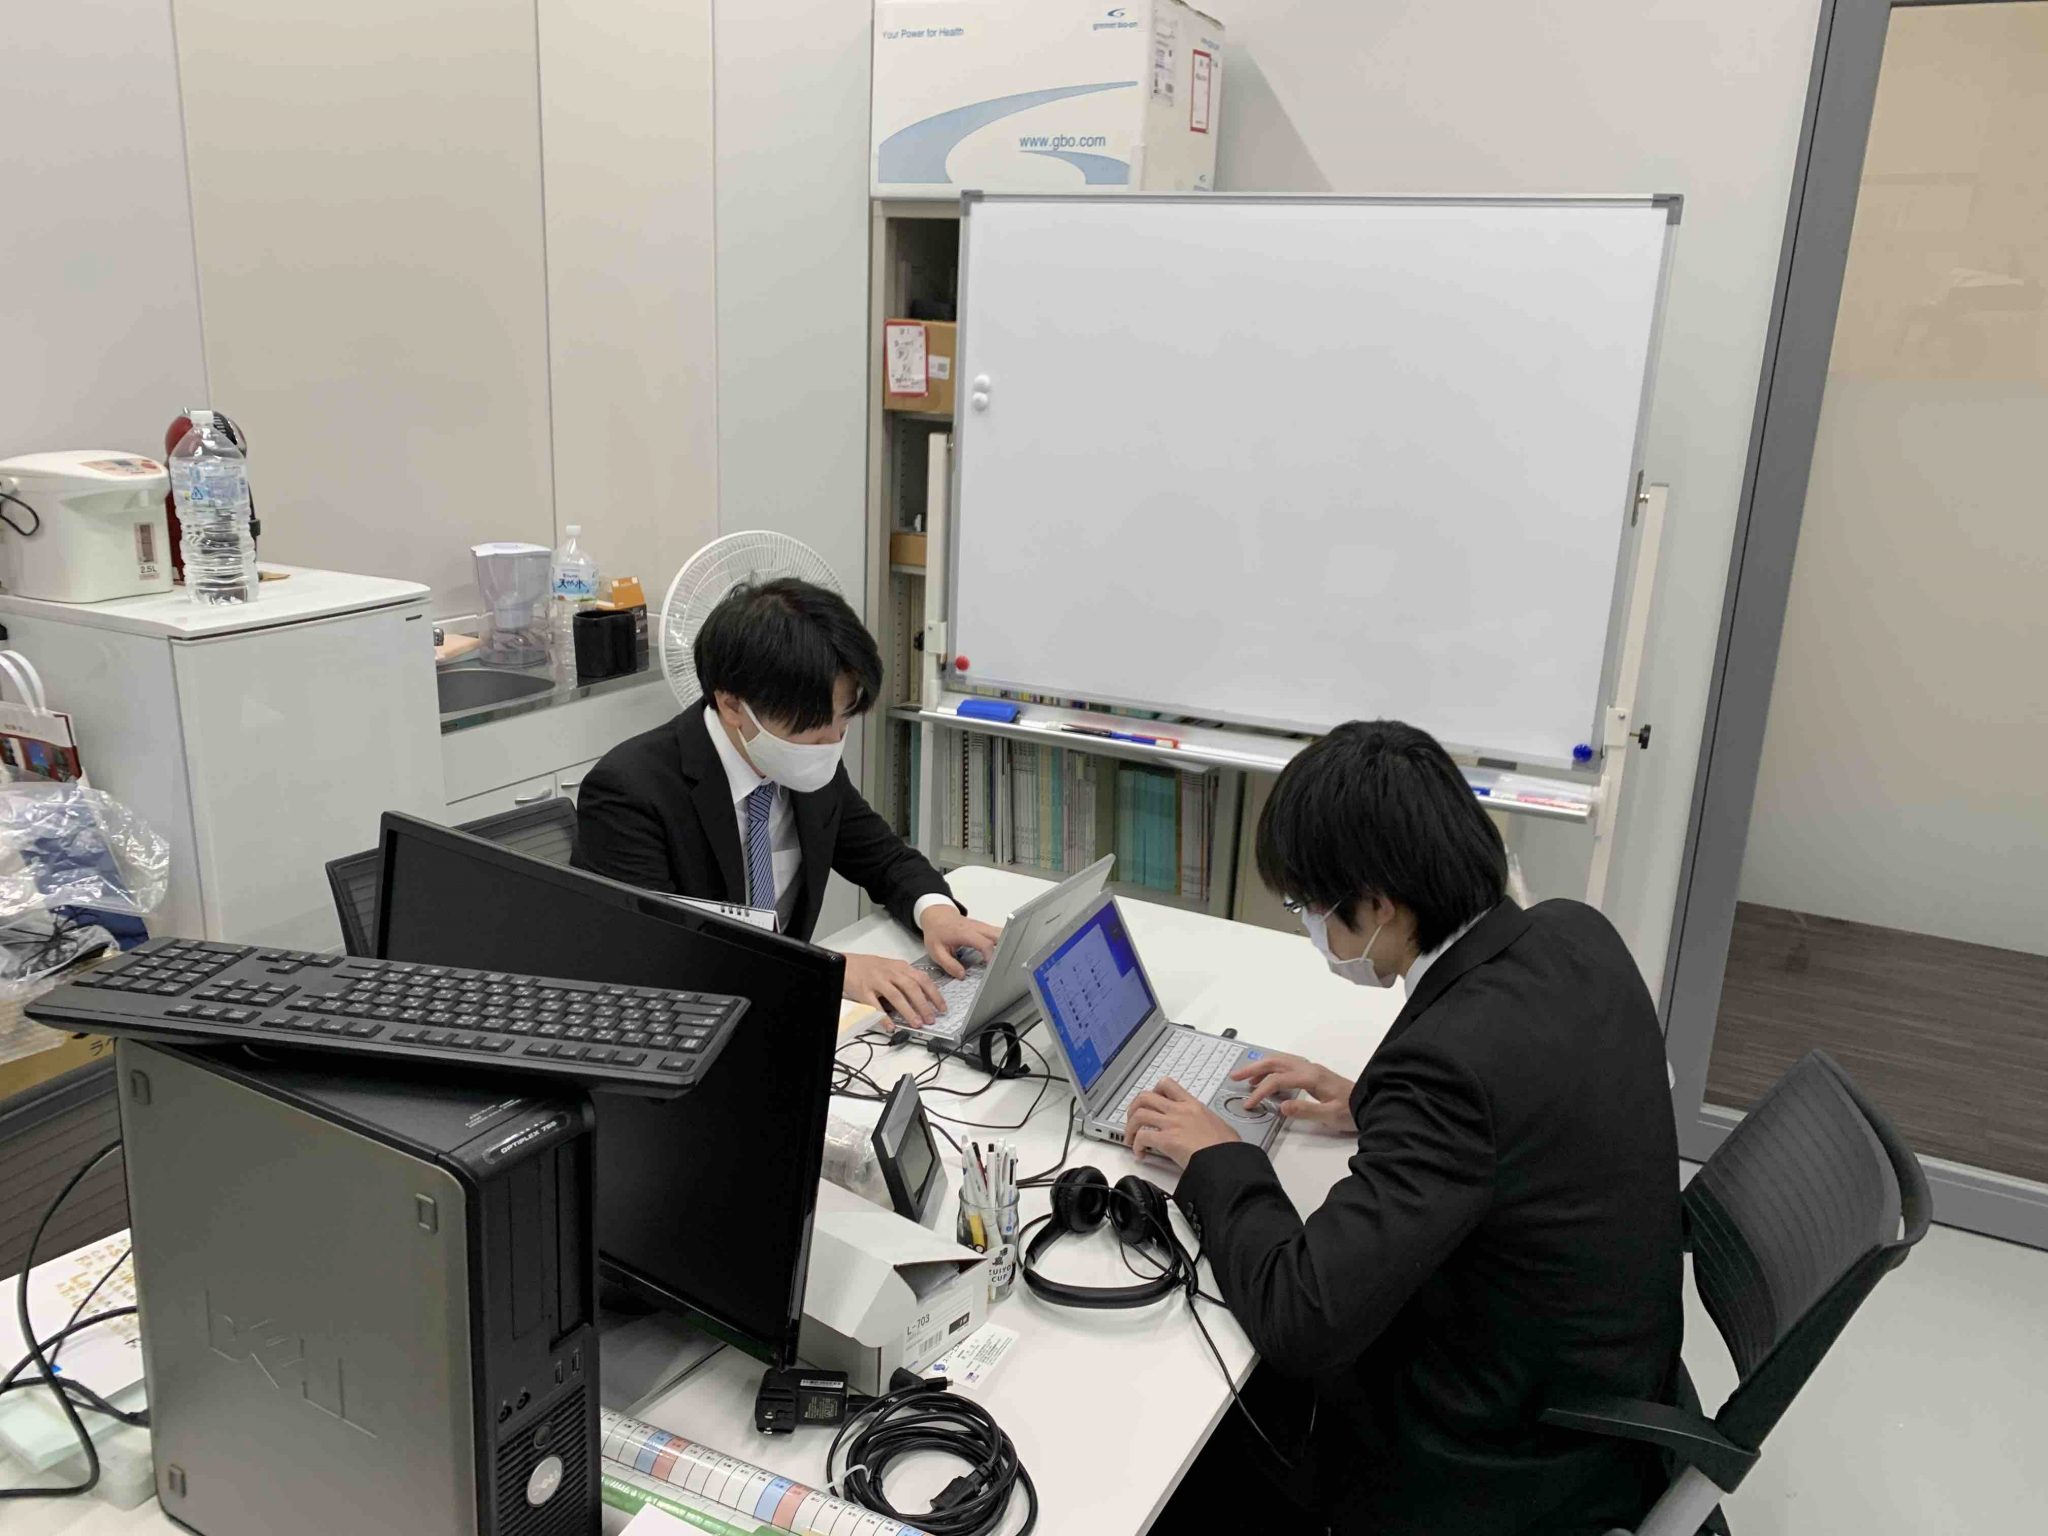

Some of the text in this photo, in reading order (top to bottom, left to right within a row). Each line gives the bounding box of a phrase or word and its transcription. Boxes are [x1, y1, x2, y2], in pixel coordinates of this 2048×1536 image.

[901, 29, 925, 38] Power
[926, 28, 938, 37] for
[939, 27, 964, 37] Health
[1019, 134, 1106, 151] www.gbo.com
[991, 1273, 1007, 1283] CUP
[906, 1314, 930, 1336] L-703
